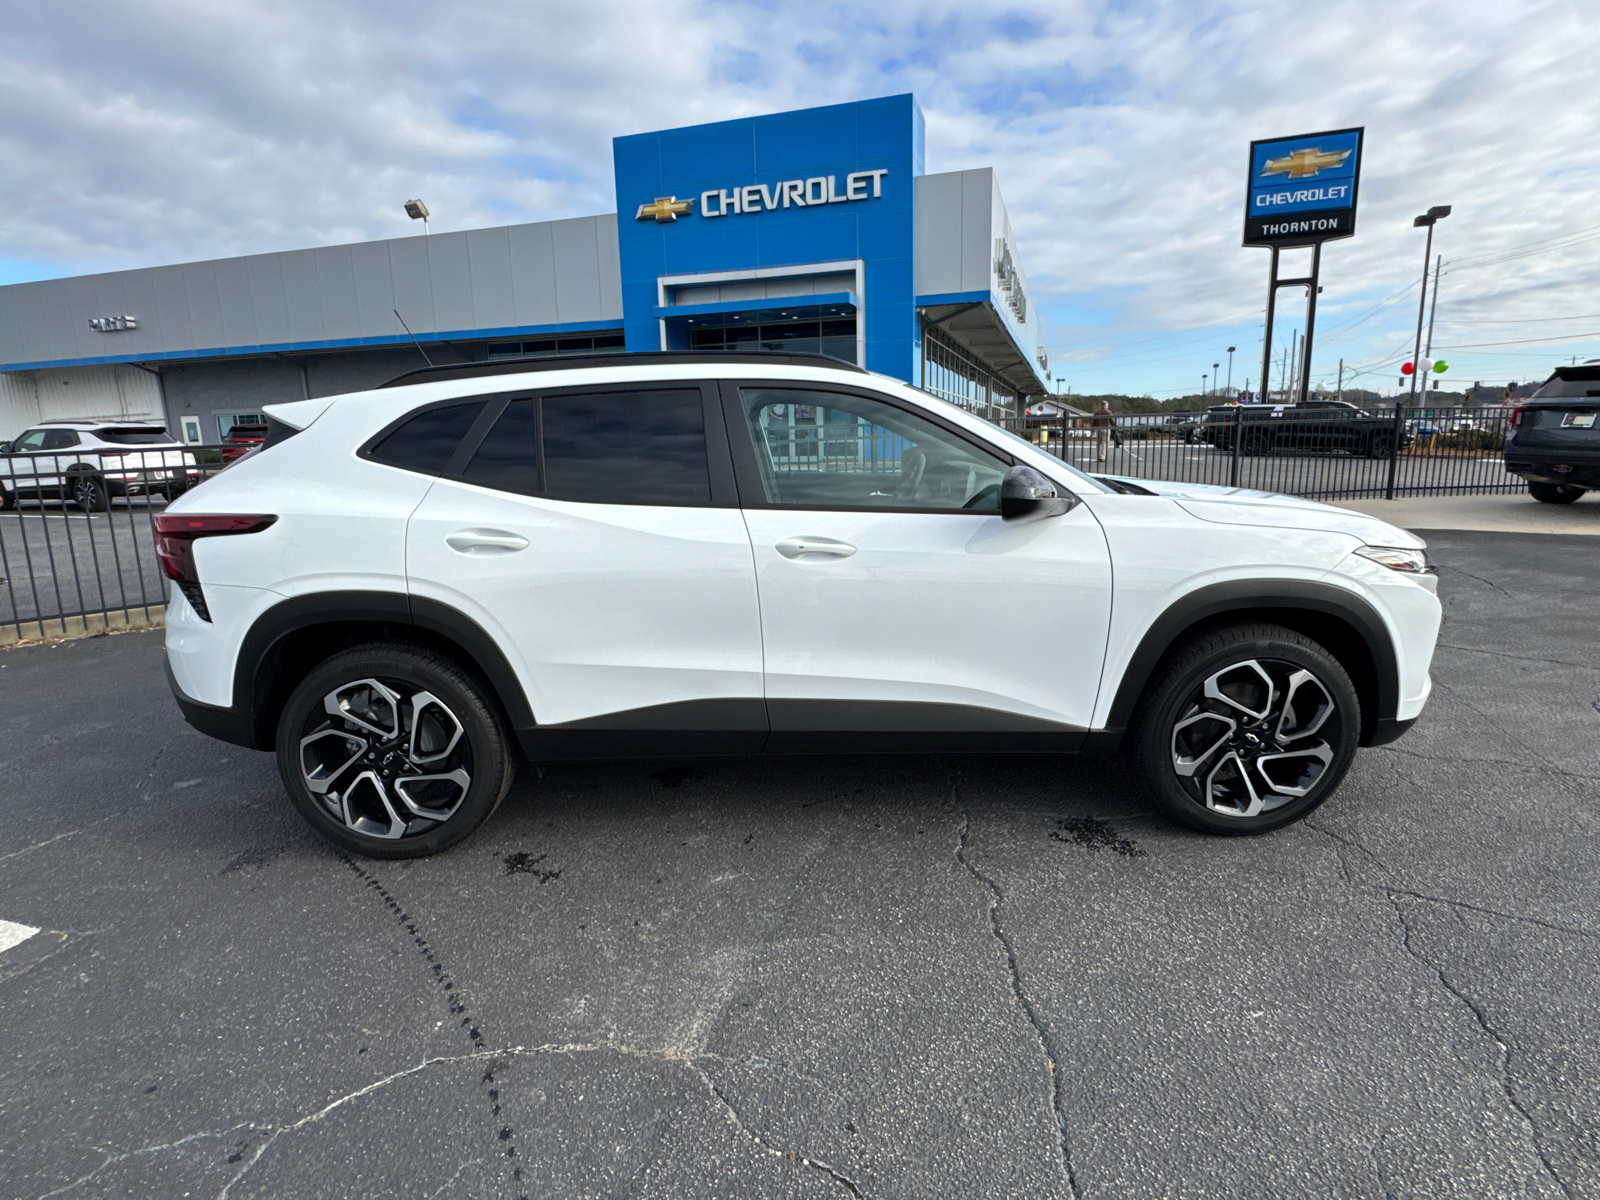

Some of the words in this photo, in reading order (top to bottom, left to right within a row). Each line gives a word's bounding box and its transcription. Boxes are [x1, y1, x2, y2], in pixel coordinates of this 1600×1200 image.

[701, 168, 888, 218] CHEVROLET
[1256, 185, 1348, 207] CHEVROLET
[1262, 218, 1338, 235] THORNTON
[88, 315, 136, 332] PARTS
